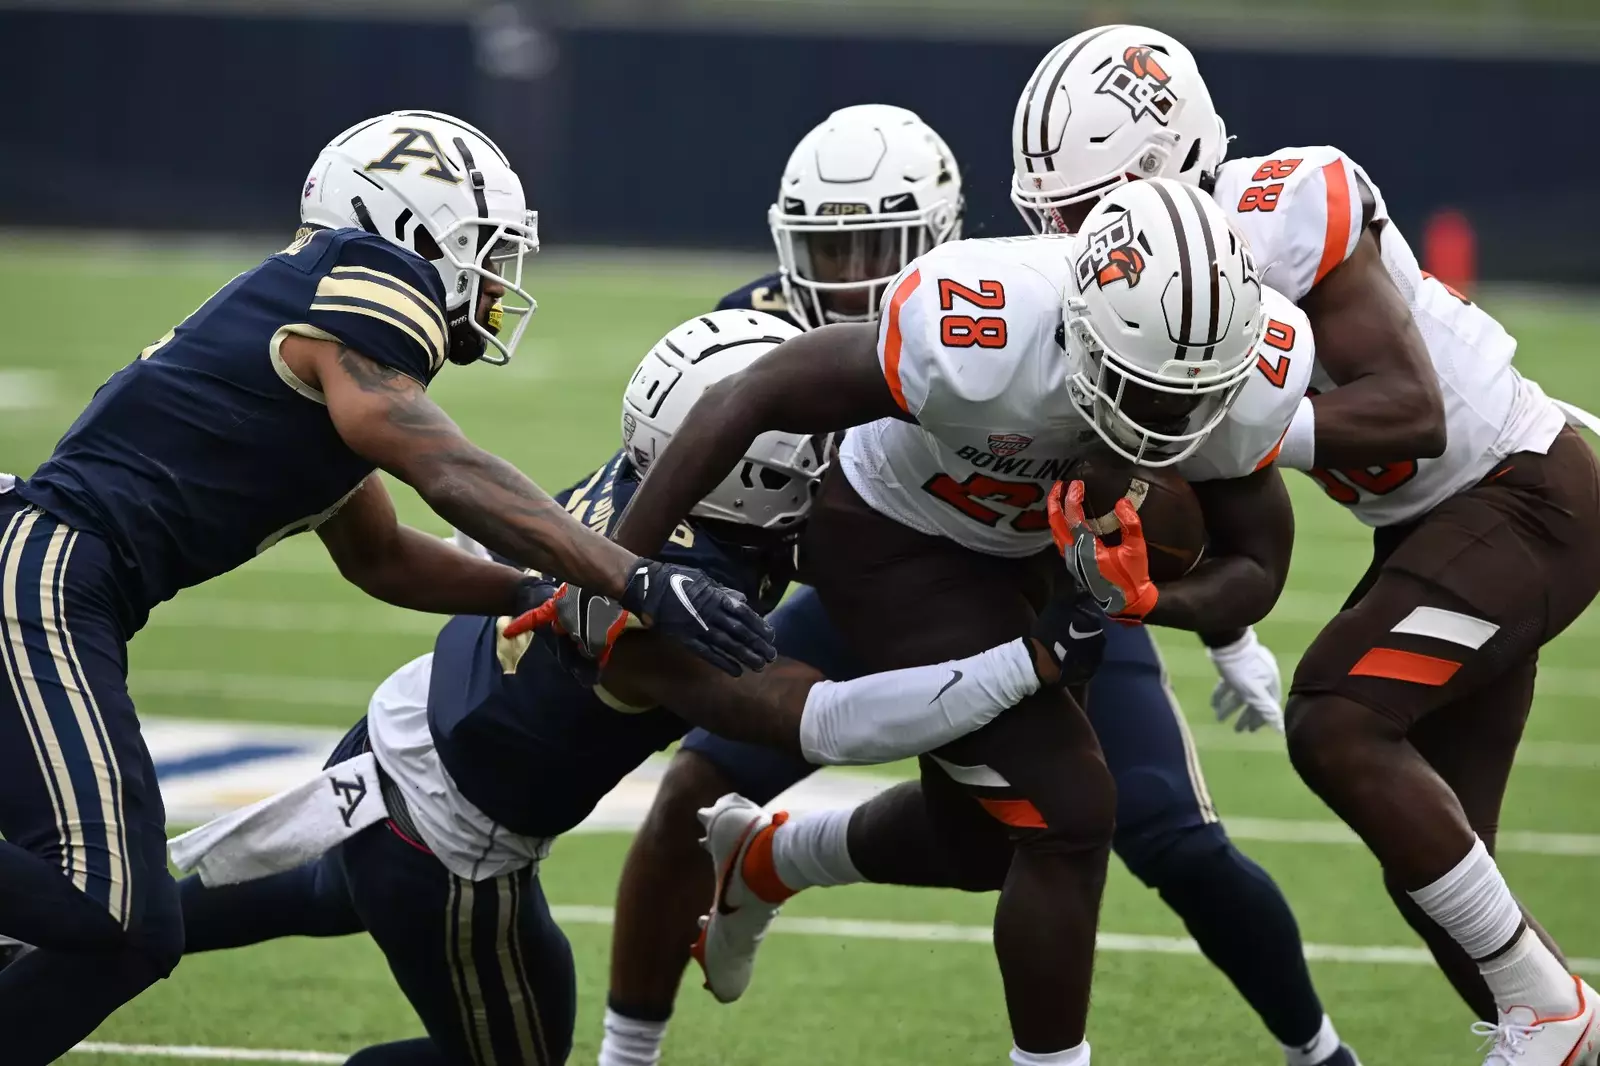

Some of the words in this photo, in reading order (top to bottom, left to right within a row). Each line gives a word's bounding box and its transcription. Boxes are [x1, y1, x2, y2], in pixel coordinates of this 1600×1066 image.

[364, 126, 464, 187] A
[822, 203, 867, 214] ZIPS
[1237, 158, 1304, 213] 88
[937, 278, 1008, 349] 28
[329, 773, 367, 828] A
